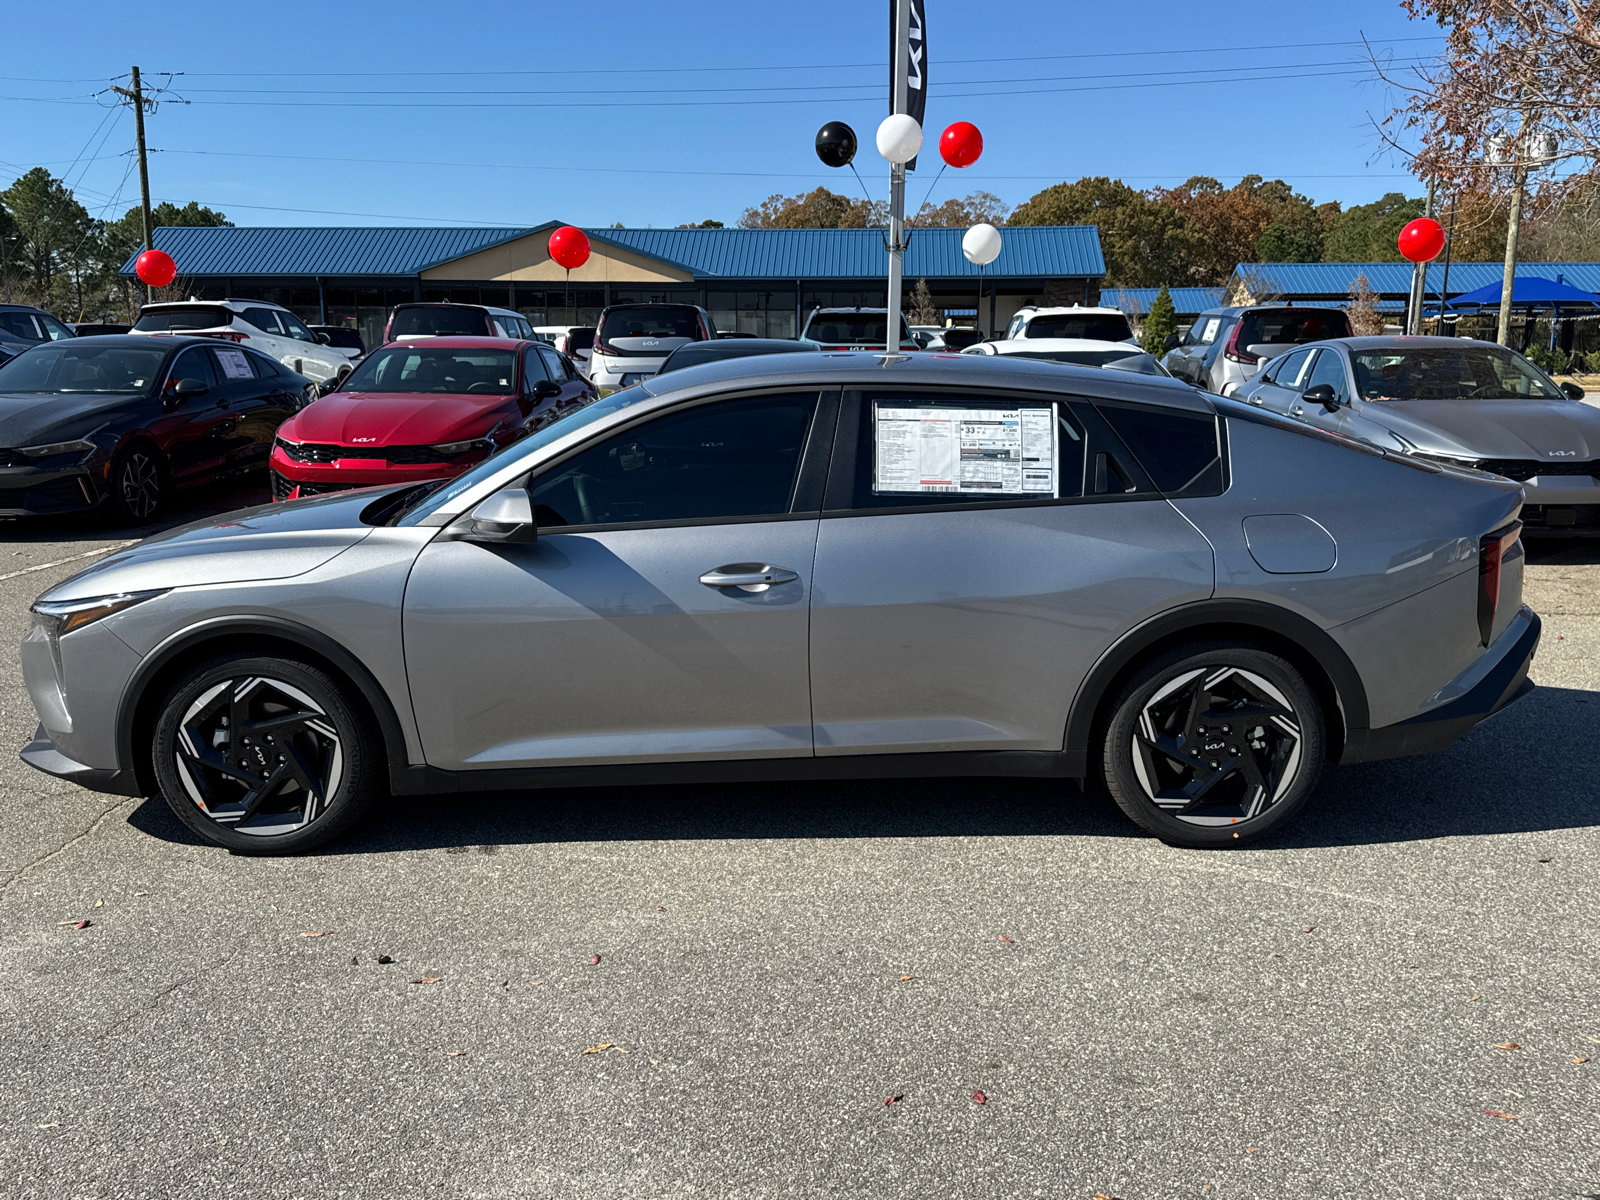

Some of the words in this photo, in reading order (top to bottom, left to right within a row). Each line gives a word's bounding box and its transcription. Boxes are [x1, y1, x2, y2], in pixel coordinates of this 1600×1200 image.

[347, 744, 359, 794] KUMHO
[1205, 742, 1225, 750] KIA
[1305, 731, 1320, 782] KUMHO
